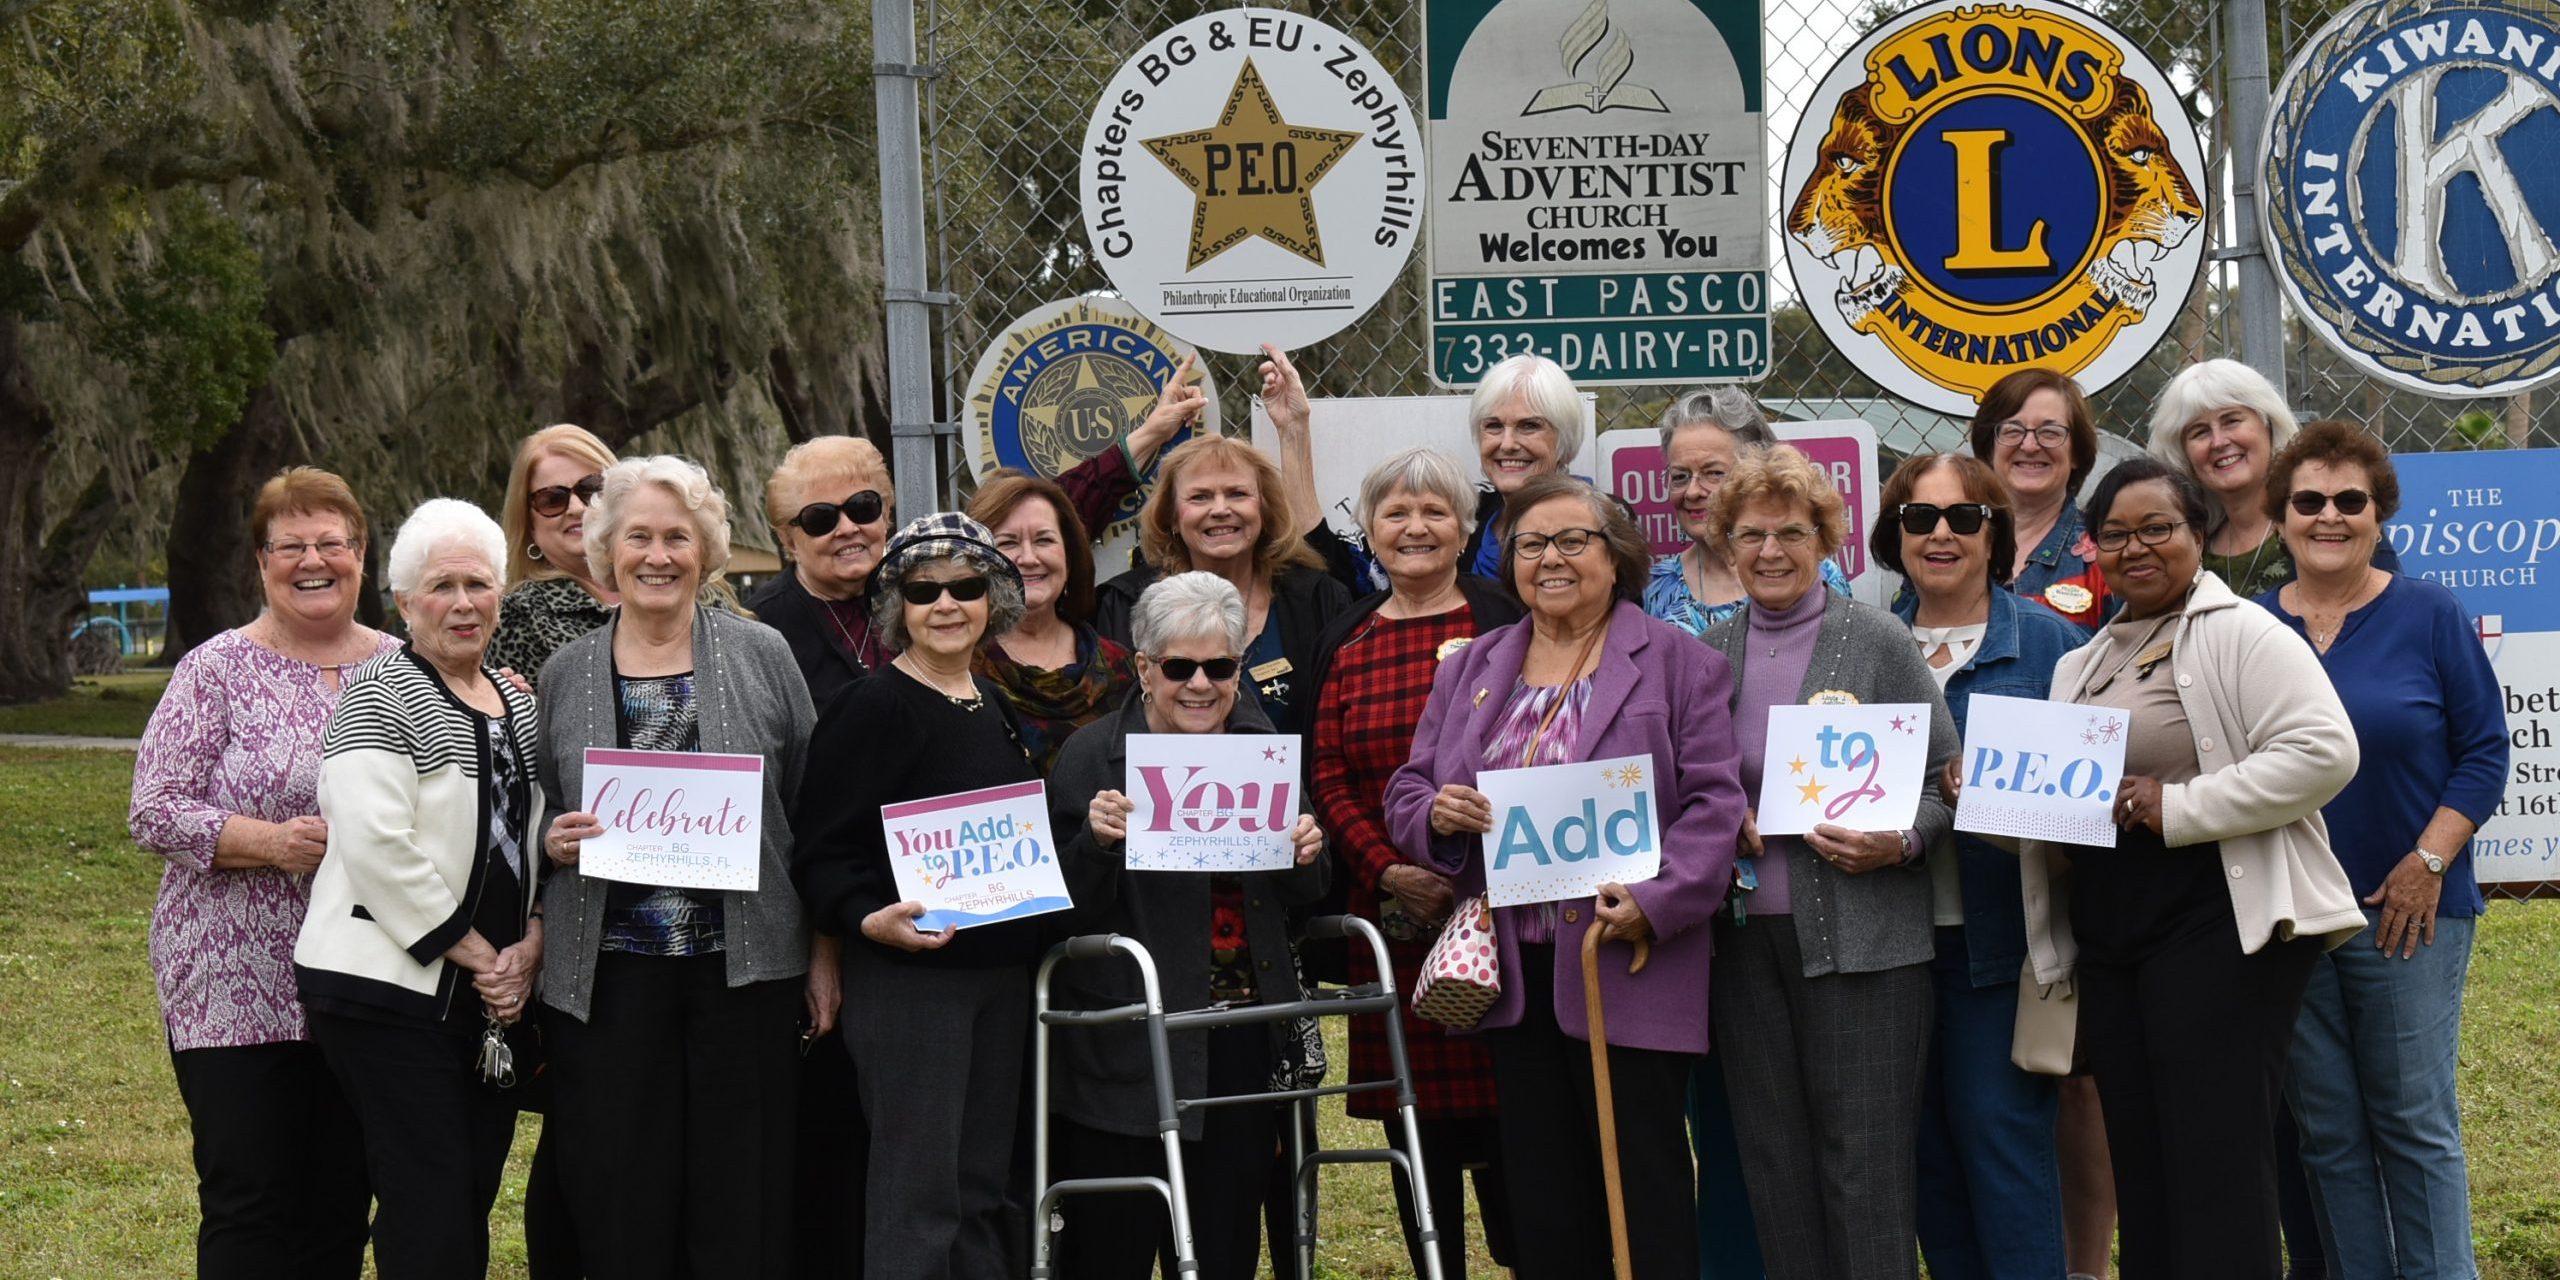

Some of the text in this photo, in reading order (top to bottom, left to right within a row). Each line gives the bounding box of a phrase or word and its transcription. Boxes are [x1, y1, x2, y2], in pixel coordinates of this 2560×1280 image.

[1884, 24, 2102, 101] LIONS
[2339, 19, 2560, 102] KIWANI
[1095, 17, 1415, 259] Chapters BG & EU Zephyrhills
[1482, 130, 1710, 162] SEVENTH-DAY
[1204, 141, 1303, 196] P.E.O.
[1448, 152, 1745, 202] ADVENTIST
[2393, 68, 2560, 297] K
[1527, 204, 1669, 230] CHURCH
[1941, 129, 2055, 276] L
[1479, 229, 1717, 263] Welcomes You
[2302, 149, 2560, 347] INTERNATI
[1163, 284, 1351, 309] Philanthropic Educational Organization
[1438, 273, 1760, 319] EAST PASCO
[1874, 291, 2121, 365] INTERNATIONAL
[2448, 488, 2503, 507] THE
[1816, 725, 1875, 768] to
[1968, 747, 2111, 802] P.E.O.
[591, 777, 751, 837] Celebrate
[1134, 766, 1291, 833] You
[1177, 809, 1213, 817] CHAPTER
[2517, 794, 2560, 816] 16t
[627, 842, 690, 853] CHAPTER BG
[893, 813, 1015, 857] You Add
[1257, 836, 1270, 846] FL
[1493, 791, 1651, 870] Add
[922, 837, 1049, 879] to P.E.O.
[958, 890, 1034, 911] ZEPHYRHILLS
[988, 882, 1006, 893] BG
